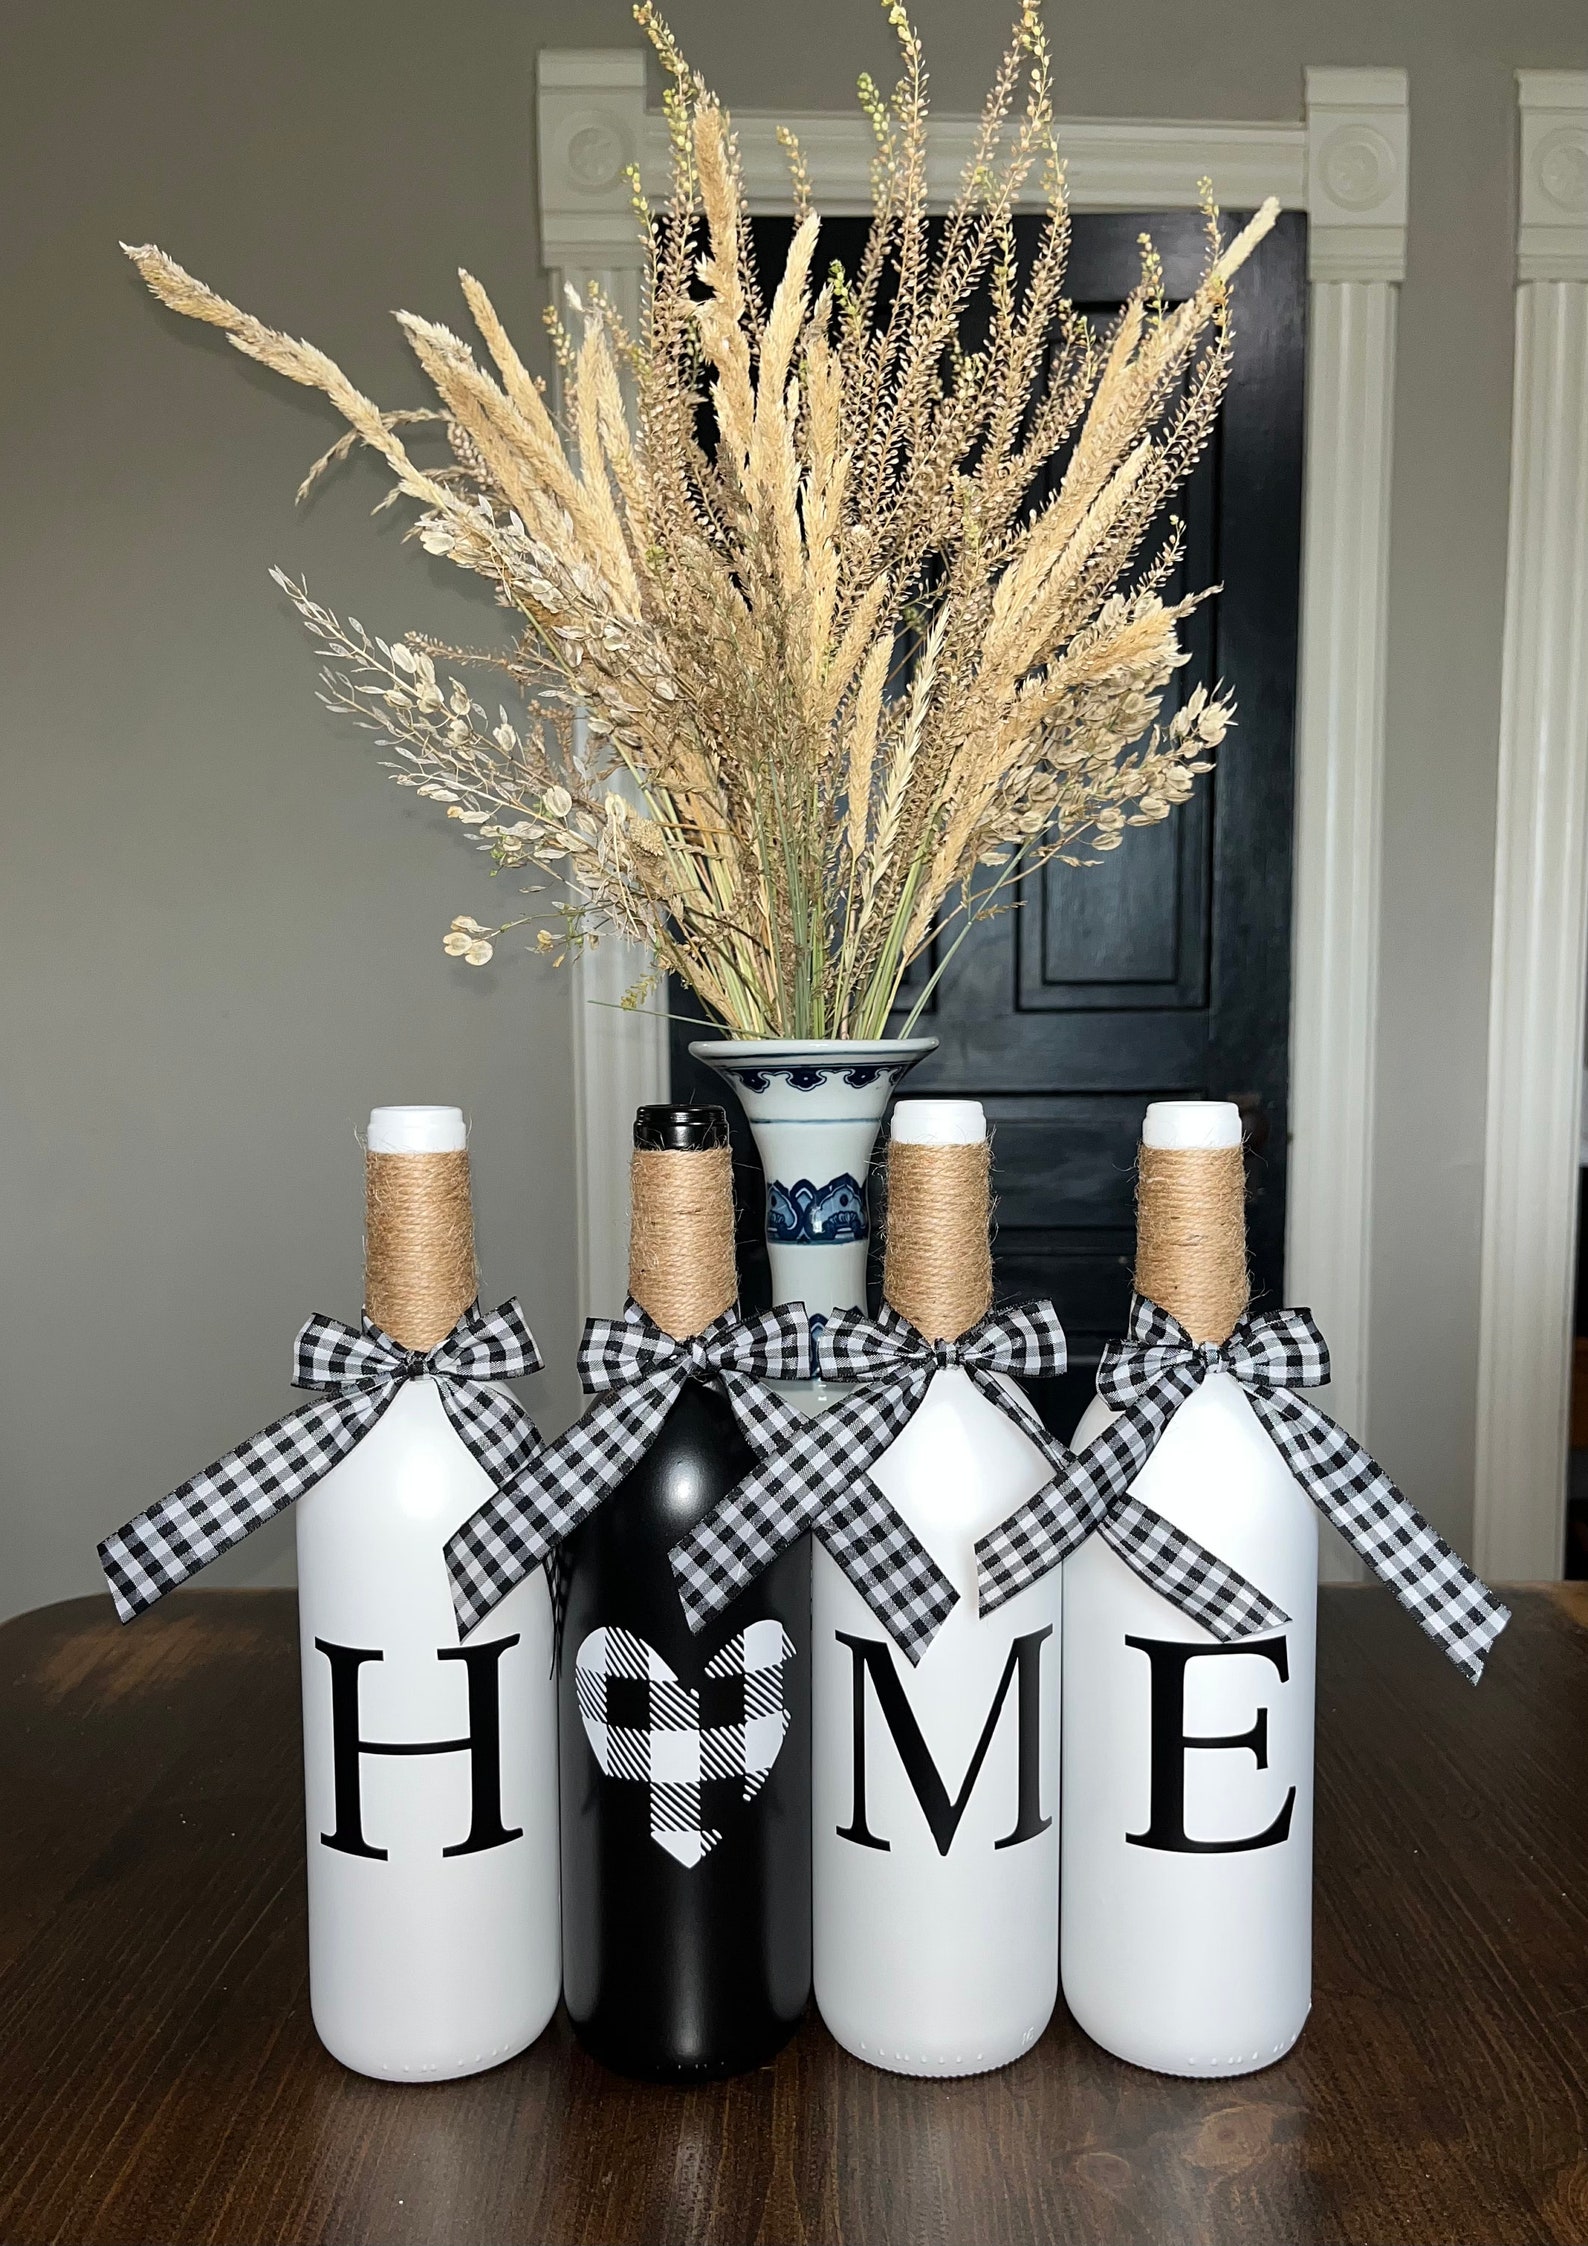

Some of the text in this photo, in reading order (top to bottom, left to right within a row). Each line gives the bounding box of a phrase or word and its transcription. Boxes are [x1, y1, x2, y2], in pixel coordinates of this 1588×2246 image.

[315, 1624, 1297, 1861] H M E
